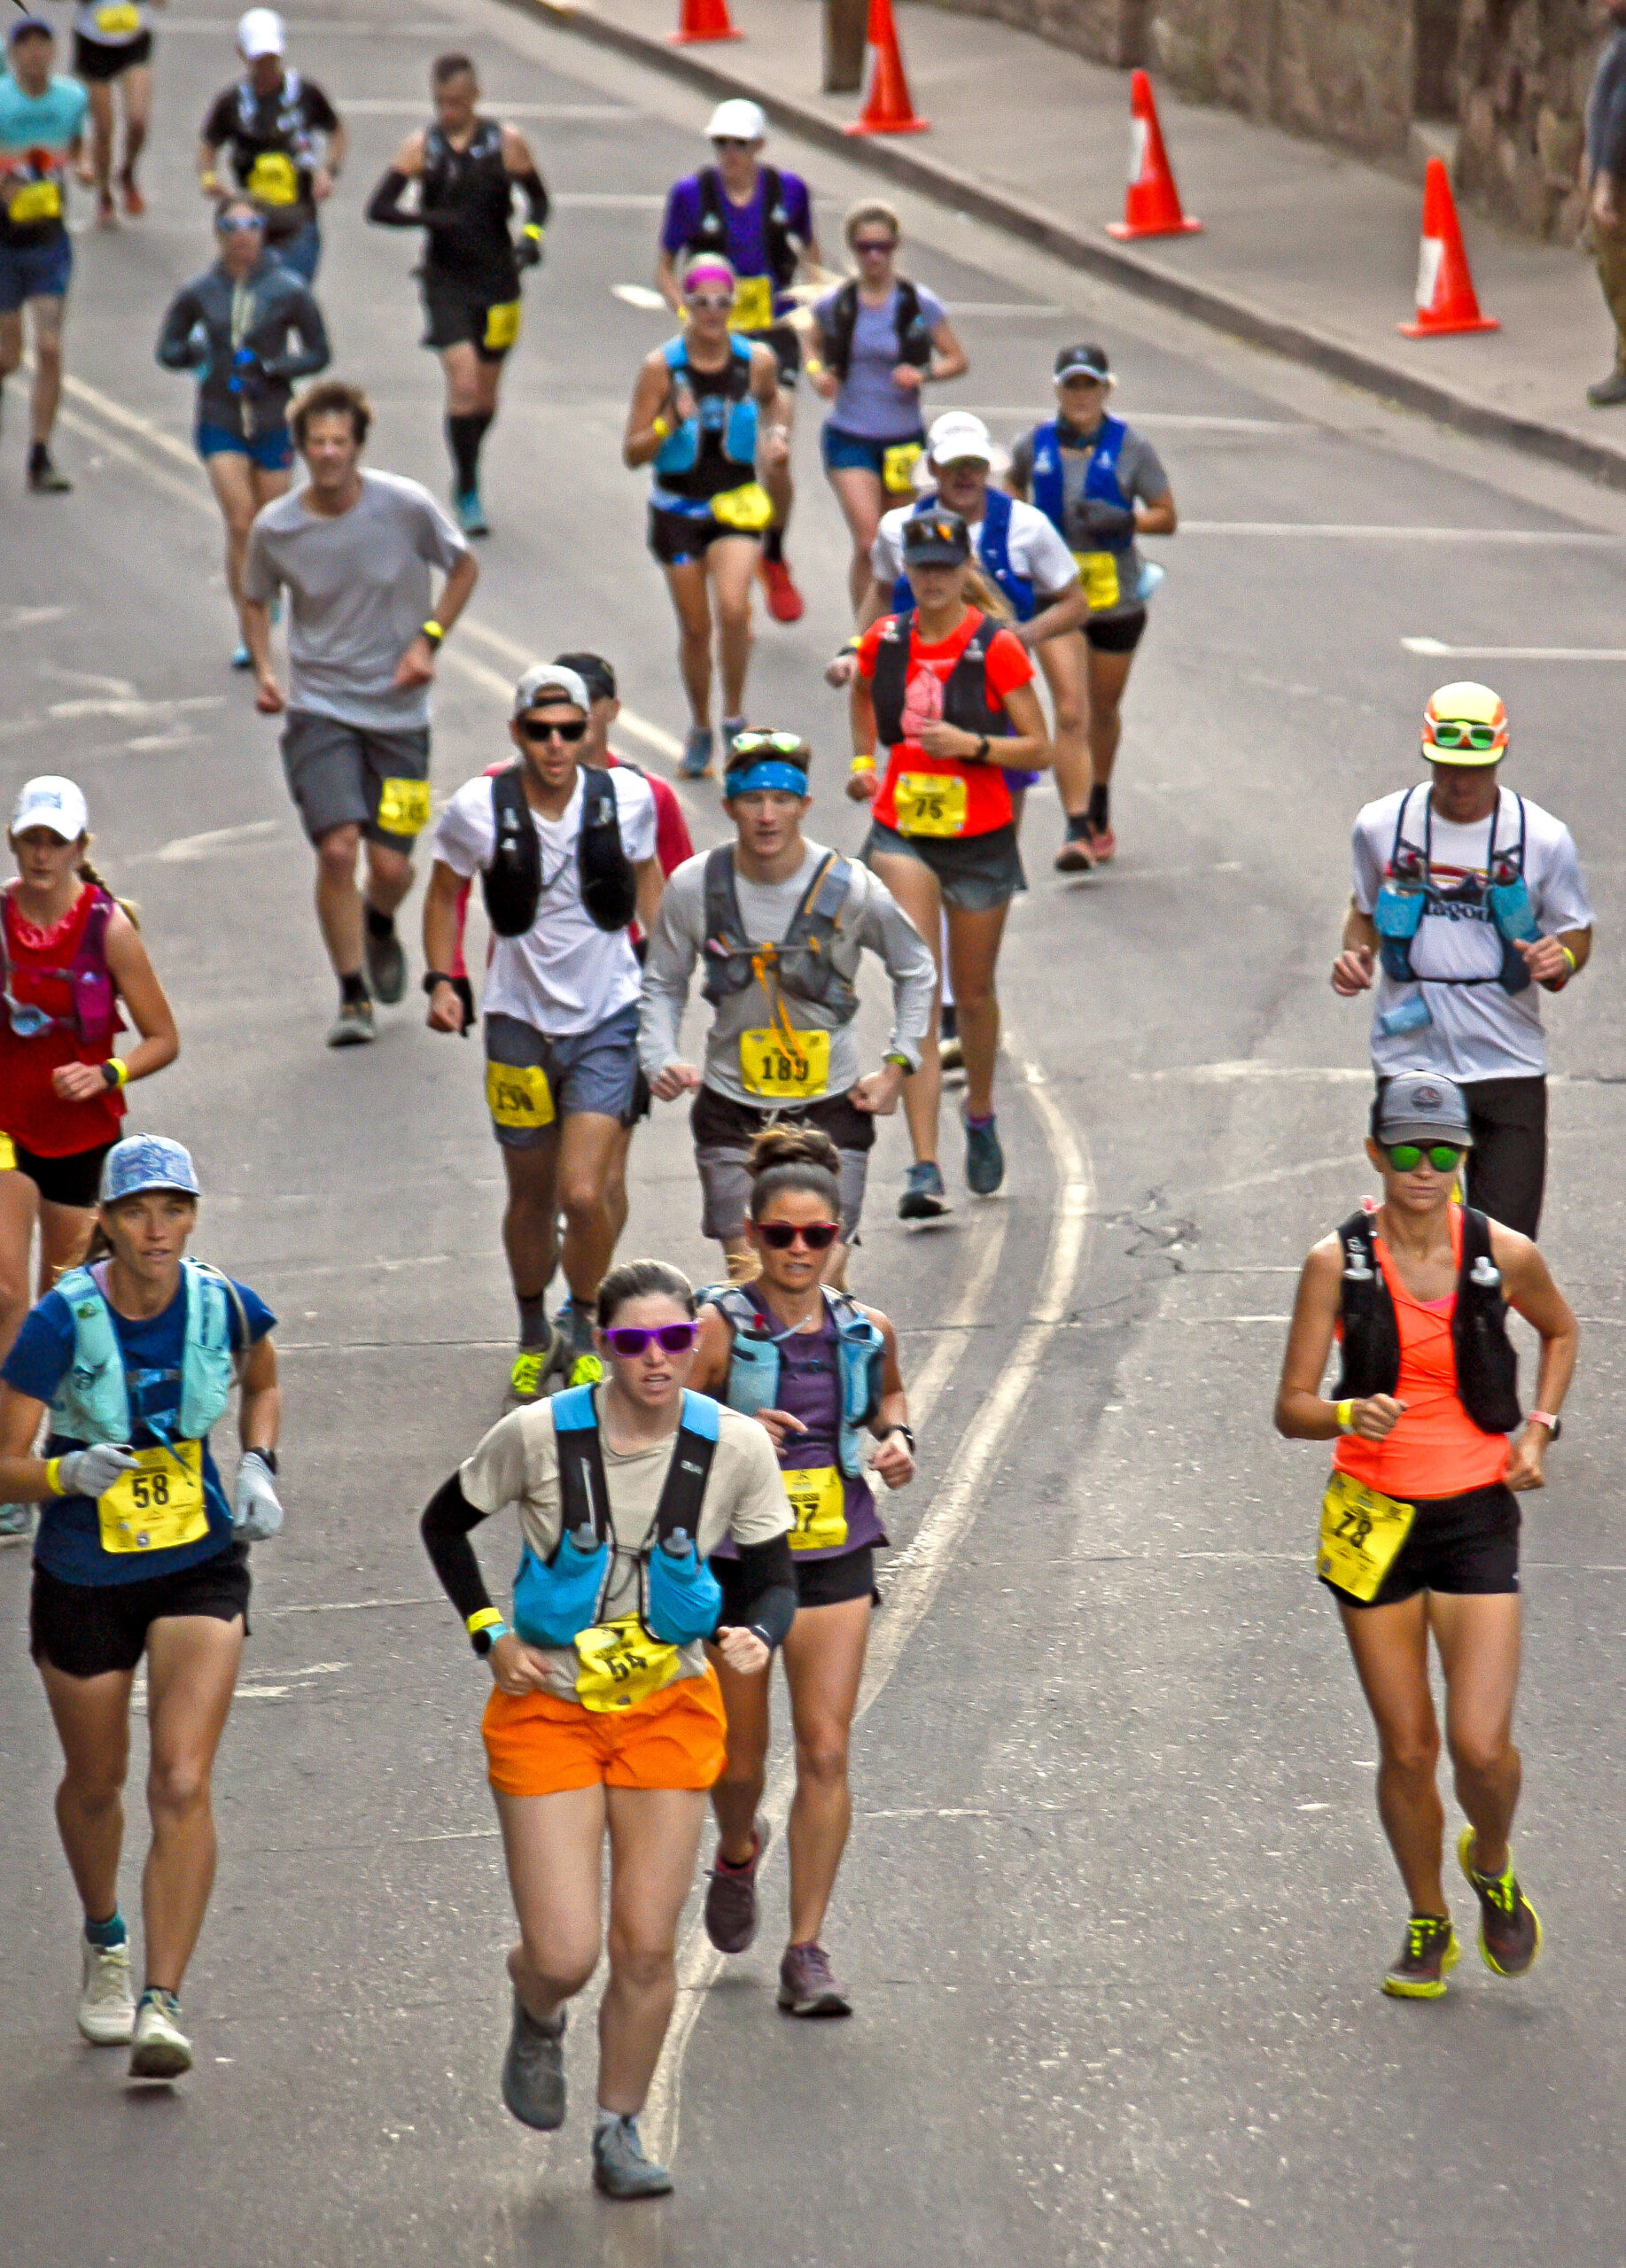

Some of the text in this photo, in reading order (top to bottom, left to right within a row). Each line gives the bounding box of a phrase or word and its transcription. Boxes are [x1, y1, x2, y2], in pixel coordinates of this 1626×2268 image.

[762, 1055, 809, 1081] 189
[131, 1473, 169, 1509] 58
[1331, 1509, 1373, 1550] 78
